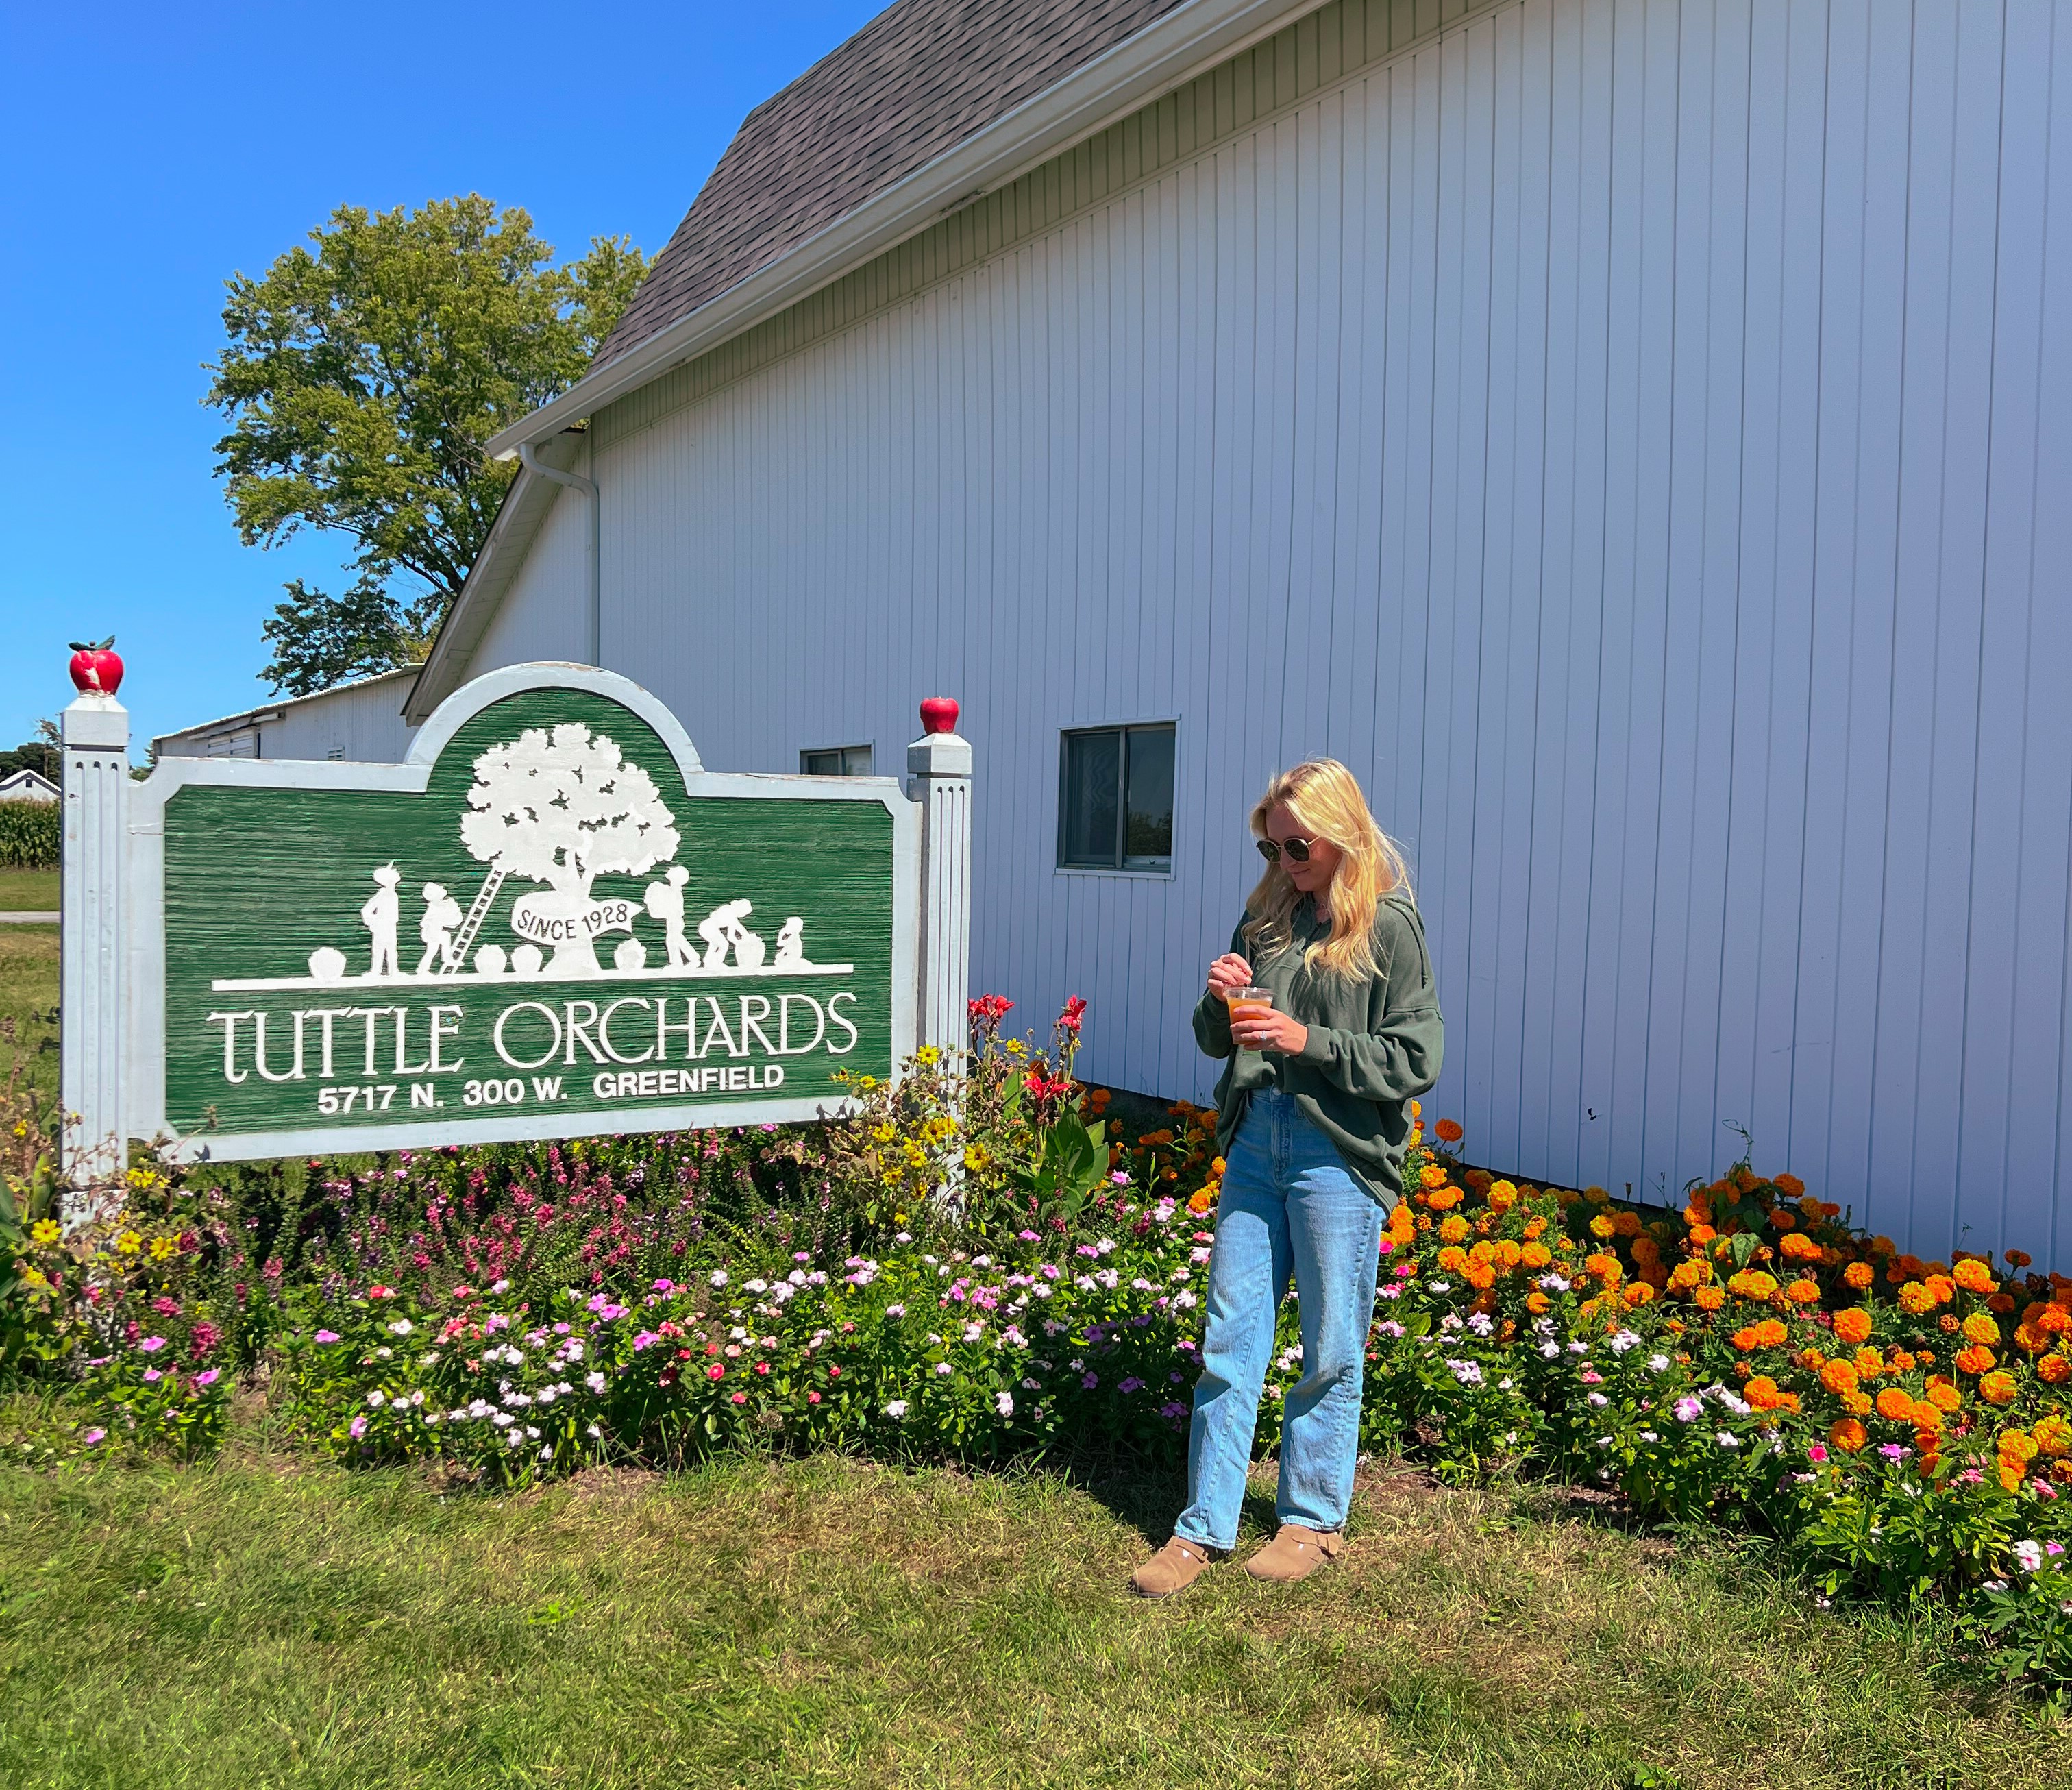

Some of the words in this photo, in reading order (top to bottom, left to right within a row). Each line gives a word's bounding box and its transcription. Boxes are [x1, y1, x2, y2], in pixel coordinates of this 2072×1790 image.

[517, 909, 577, 940] SINCE
[582, 903, 628, 933] 1928
[206, 1005, 465, 1084] TUTTLE
[493, 992, 859, 1069] ORCHARDS
[317, 1085, 397, 1114] 5717
[410, 1083, 444, 1108] N.
[463, 1078, 525, 1106] 300
[532, 1077, 568, 1101] W.
[593, 1064, 785, 1099] GREENFIELD
